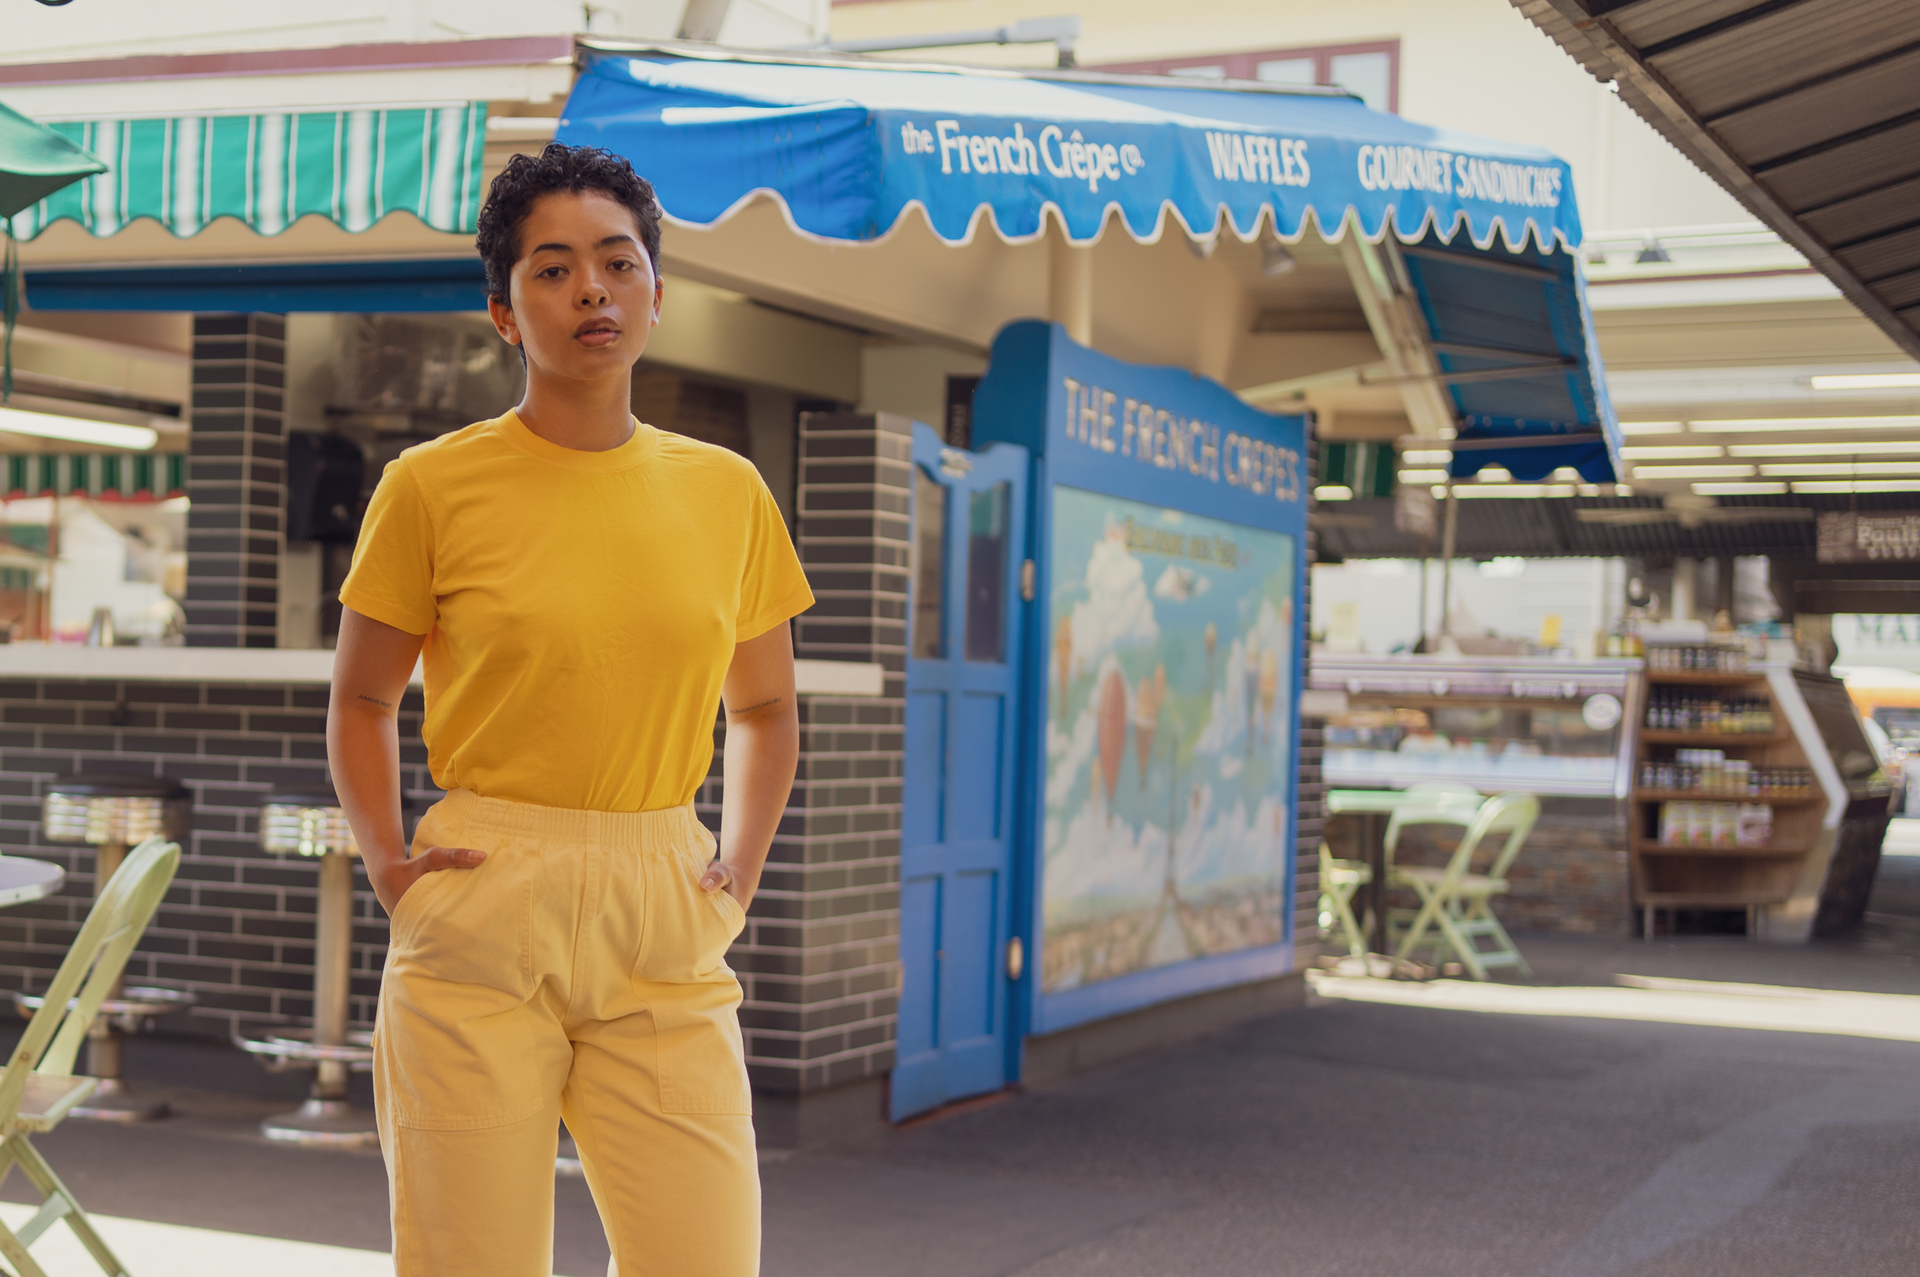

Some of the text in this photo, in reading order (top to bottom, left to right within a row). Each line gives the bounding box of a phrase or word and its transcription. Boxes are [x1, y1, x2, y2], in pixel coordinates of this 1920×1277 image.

[902, 121, 935, 154] the
[935, 119, 1041, 175] French
[1038, 125, 1121, 193] Crêpe
[1205, 131, 1312, 188] WAFFLES
[1357, 144, 1563, 207] GOURMET SANDWICHES
[1064, 377, 1300, 503] THE FRENCH CREPES
